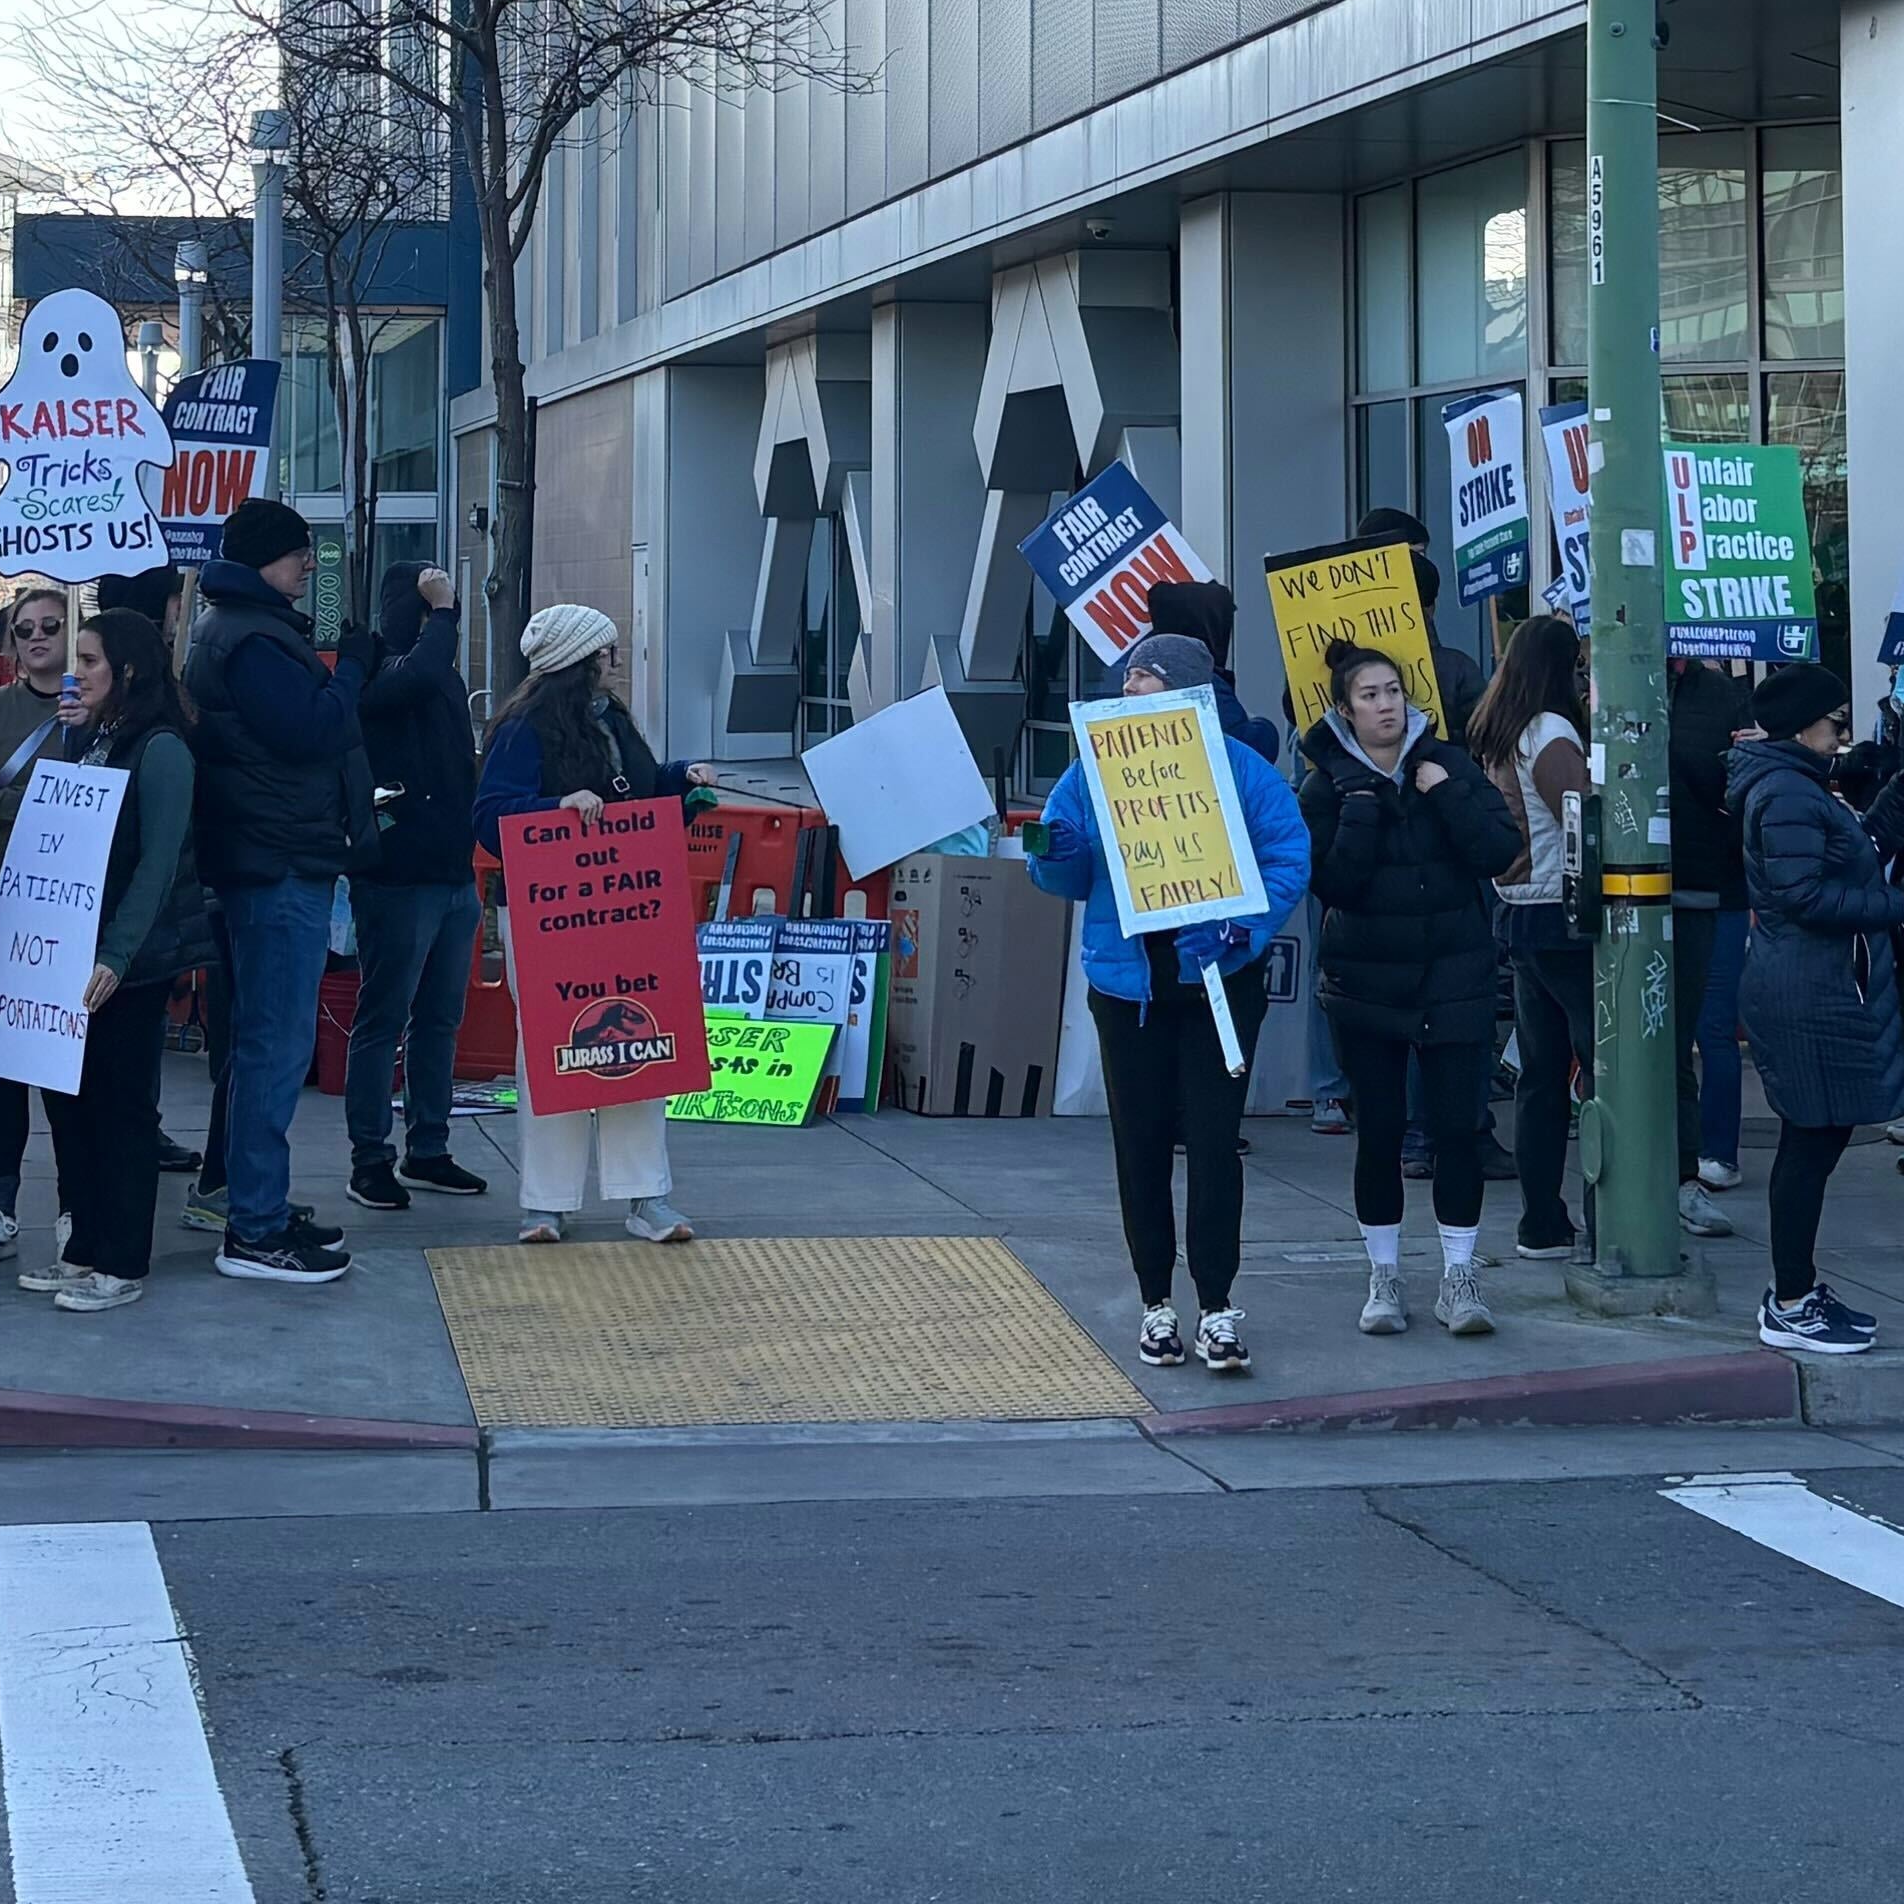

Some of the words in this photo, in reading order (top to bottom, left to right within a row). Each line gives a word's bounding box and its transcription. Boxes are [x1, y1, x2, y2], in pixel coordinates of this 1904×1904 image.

[199, 366, 246, 401] FAIR
[0, 398, 146, 443] KAISER
[173, 401, 258, 435] CONTRACT
[1467, 415, 1492, 468] ON
[16, 449, 113, 487] Tricks
[161, 449, 256, 518] NOW
[1672, 457, 1754, 490] Unfair
[1459, 463, 1516, 528] STRIKE
[1678, 493, 1757, 527] Labor
[108, 513, 154, 549] US!
[1052, 496, 1109, 552] FAIR
[1059, 506, 1143, 587] CONTRACT
[1680, 531, 1794, 564] Practice
[1328, 551, 1391, 590] DON'T
[1083, 532, 1195, 651] NOW
[1681, 576, 1795, 619] STRIKE
[1286, 616, 1357, 659] FIND
[1360, 602, 1416, 638] THIS
[1090, 717, 1193, 760] PATIENTS
[1122, 759, 1186, 788] Before
[33, 774, 110, 812] INVEST
[37, 833, 64, 853] IN
[523, 823, 571, 844] Can
[599, 810, 656, 836] hold
[575, 846, 620, 866] out
[0, 866, 96, 911] PATIENTS
[528, 882, 568, 904] for
[578, 881, 593, 897] a
[603, 869, 662, 894] FAIR
[1141, 864, 1235, 911] FAIRLY!
[539, 899, 662, 932] contract?
[9, 932, 59, 966] NOT
[555, 981, 606, 1001] You
[615, 973, 659, 996] bet
[702, 959, 764, 1004] STR
[558, 1043, 615, 1072] JURASS
[618, 1042, 630, 1066] I
[633, 1038, 673, 1062] CAN
[706, 1026, 791, 1053] SER
[710, 1056, 759, 1074] sts
[766, 1058, 793, 1077] in
